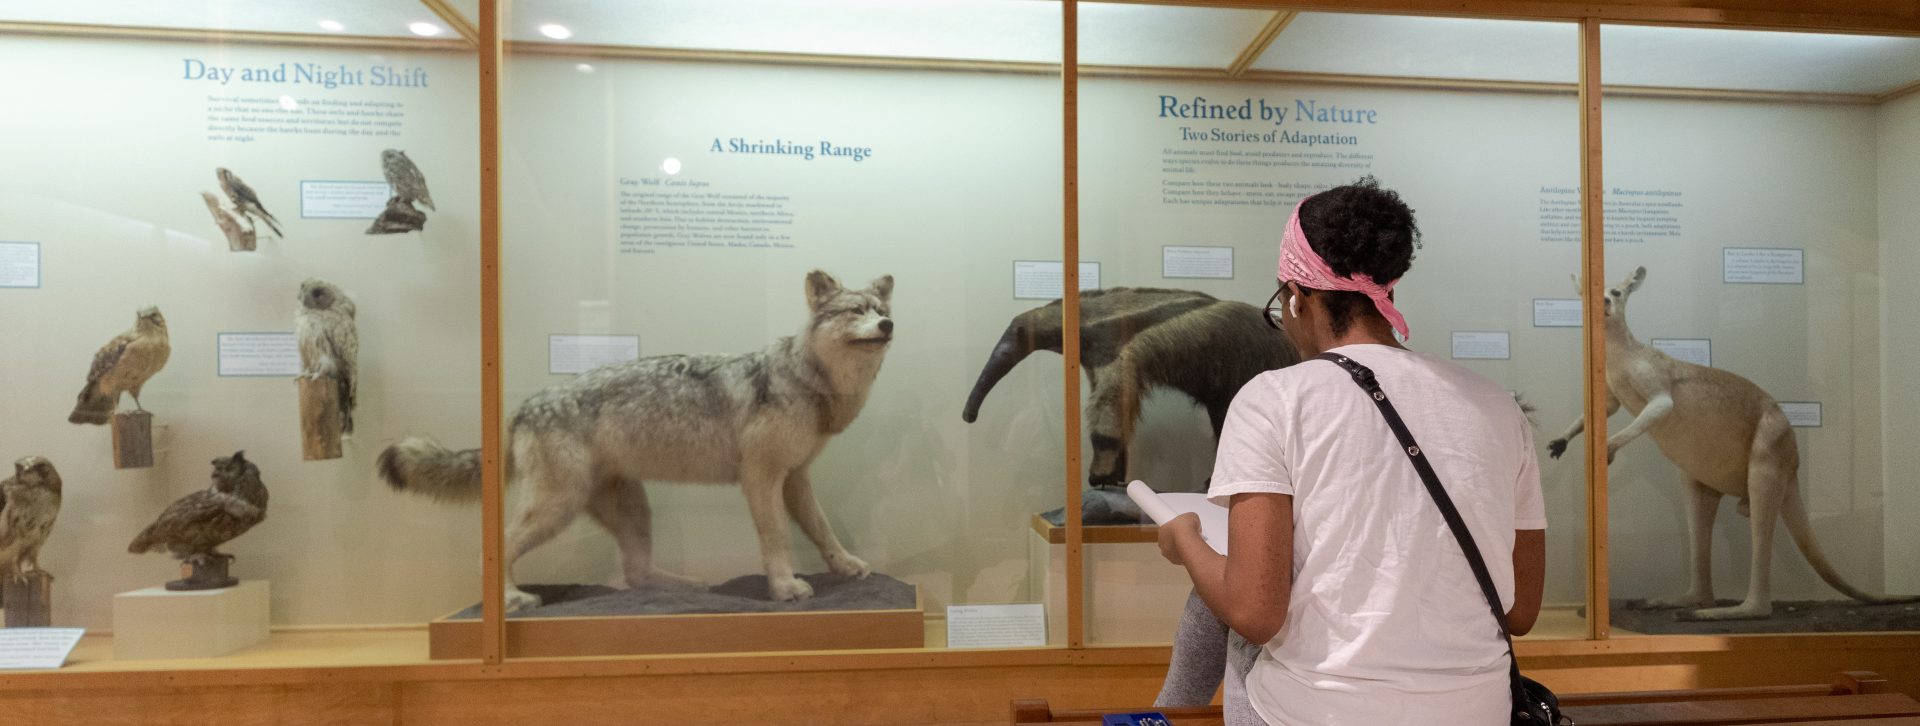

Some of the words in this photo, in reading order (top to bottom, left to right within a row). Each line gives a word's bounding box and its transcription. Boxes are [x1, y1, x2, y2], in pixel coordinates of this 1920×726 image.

[183, 58, 234, 86] Day
[241, 63, 286, 83] and
[294, 62, 364, 88] Night
[370, 65, 428, 88] Shift
[1158, 95, 1252, 120] Refined
[1260, 98, 1288, 125] by
[1295, 100, 1378, 124] Nature
[1179, 126, 1208, 142] Two
[1211, 128, 1260, 142] Stories
[1263, 130, 1277, 143] of
[1280, 130, 1358, 147] Adaptation
[710, 138, 723, 152] A
[728, 138, 814, 160] Shrinking
[820, 140, 872, 162] Range
[620, 177, 638, 186] Gray
[640, 177, 660, 185] Wolf
[1540, 186, 1575, 194] Antilopine
[1612, 188, 1643, 197] Macropus
[1645, 189, 1682, 197] antilopinus
